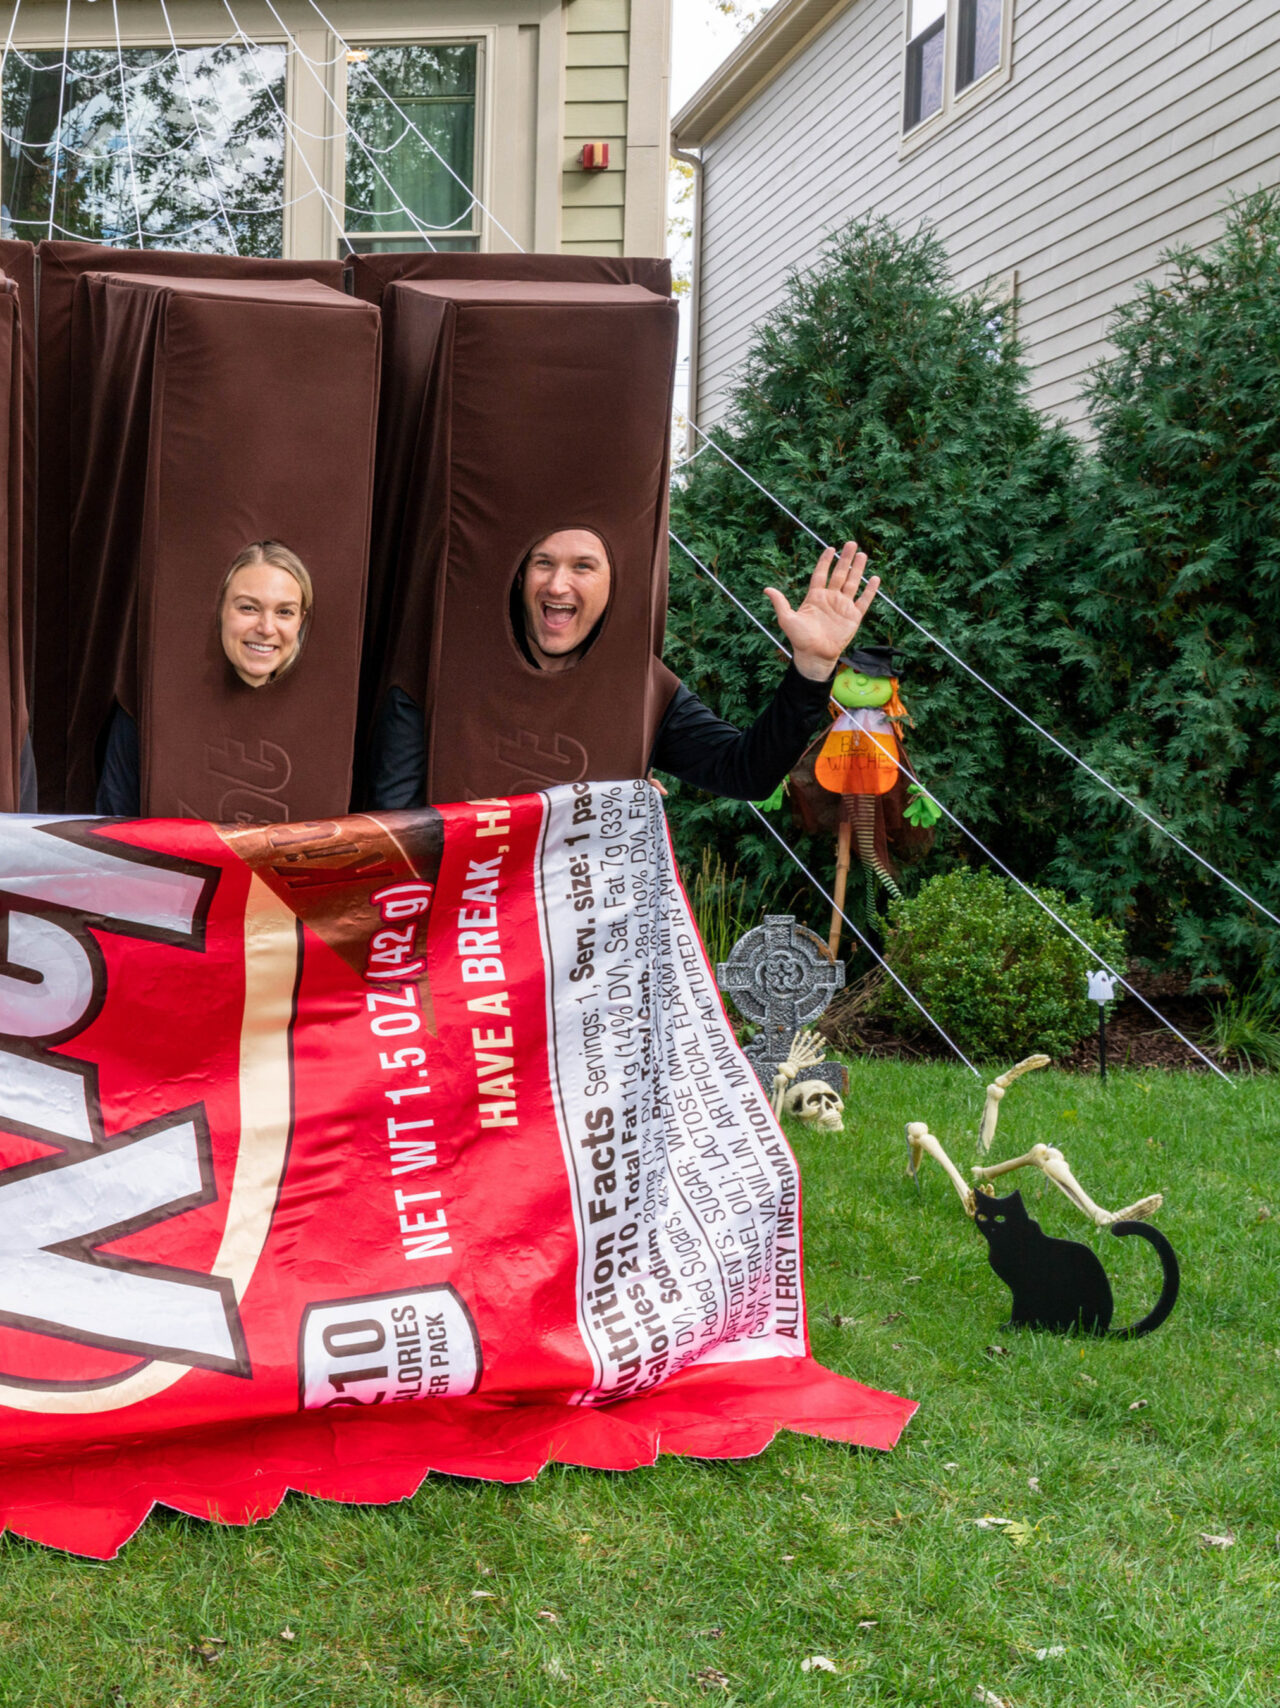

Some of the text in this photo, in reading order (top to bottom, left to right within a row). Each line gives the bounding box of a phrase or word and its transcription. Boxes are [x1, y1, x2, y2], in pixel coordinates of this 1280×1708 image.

[563, 833, 590, 846] 1
[600, 787, 628, 839] (33%
[566, 854, 595, 911] size:
[600, 844, 629, 872] 7g
[458, 844, 509, 983] BREAK,
[603, 876, 627, 908] Fat
[670, 908, 685, 927] IN
[569, 918, 596, 982] Serv.
[604, 914, 629, 953] Sat.
[467, 991, 510, 1017] A
[575, 985, 602, 1004] 1,
[676, 934, 750, 1088] MANUFACTURED
[578, 1008, 609, 1097] Servings:
[607, 1006, 636, 1058] (14%
[367, 884, 453, 1260] NET WT 1.5 OZ (42 g)
[471, 1026, 519, 1128] HAVE
[621, 1062, 639, 1101] 11g
[680, 1032, 740, 1128] ARTIFICIAL
[621, 1105, 639, 1144] Fat
[674, 1086, 731, 1171] LACTOSE
[580, 1106, 617, 1224] Facts
[622, 1149, 641, 1211] Total
[675, 1156, 726, 1224] SUGAR;
[740, 1091, 796, 1238] INFORMATION:
[617, 1212, 642, 1278] 210,
[645, 1228, 683, 1304] Sodium
[664, 1211, 707, 1273] Sugars,
[738, 1218, 762, 1297] KERNEL
[587, 1232, 641, 1402] Nutrition
[688, 1279, 718, 1336] Added
[775, 1246, 799, 1339] ALLERGY
[425, 1313, 449, 1367] PACK
[626, 1284, 670, 1392] Calories
